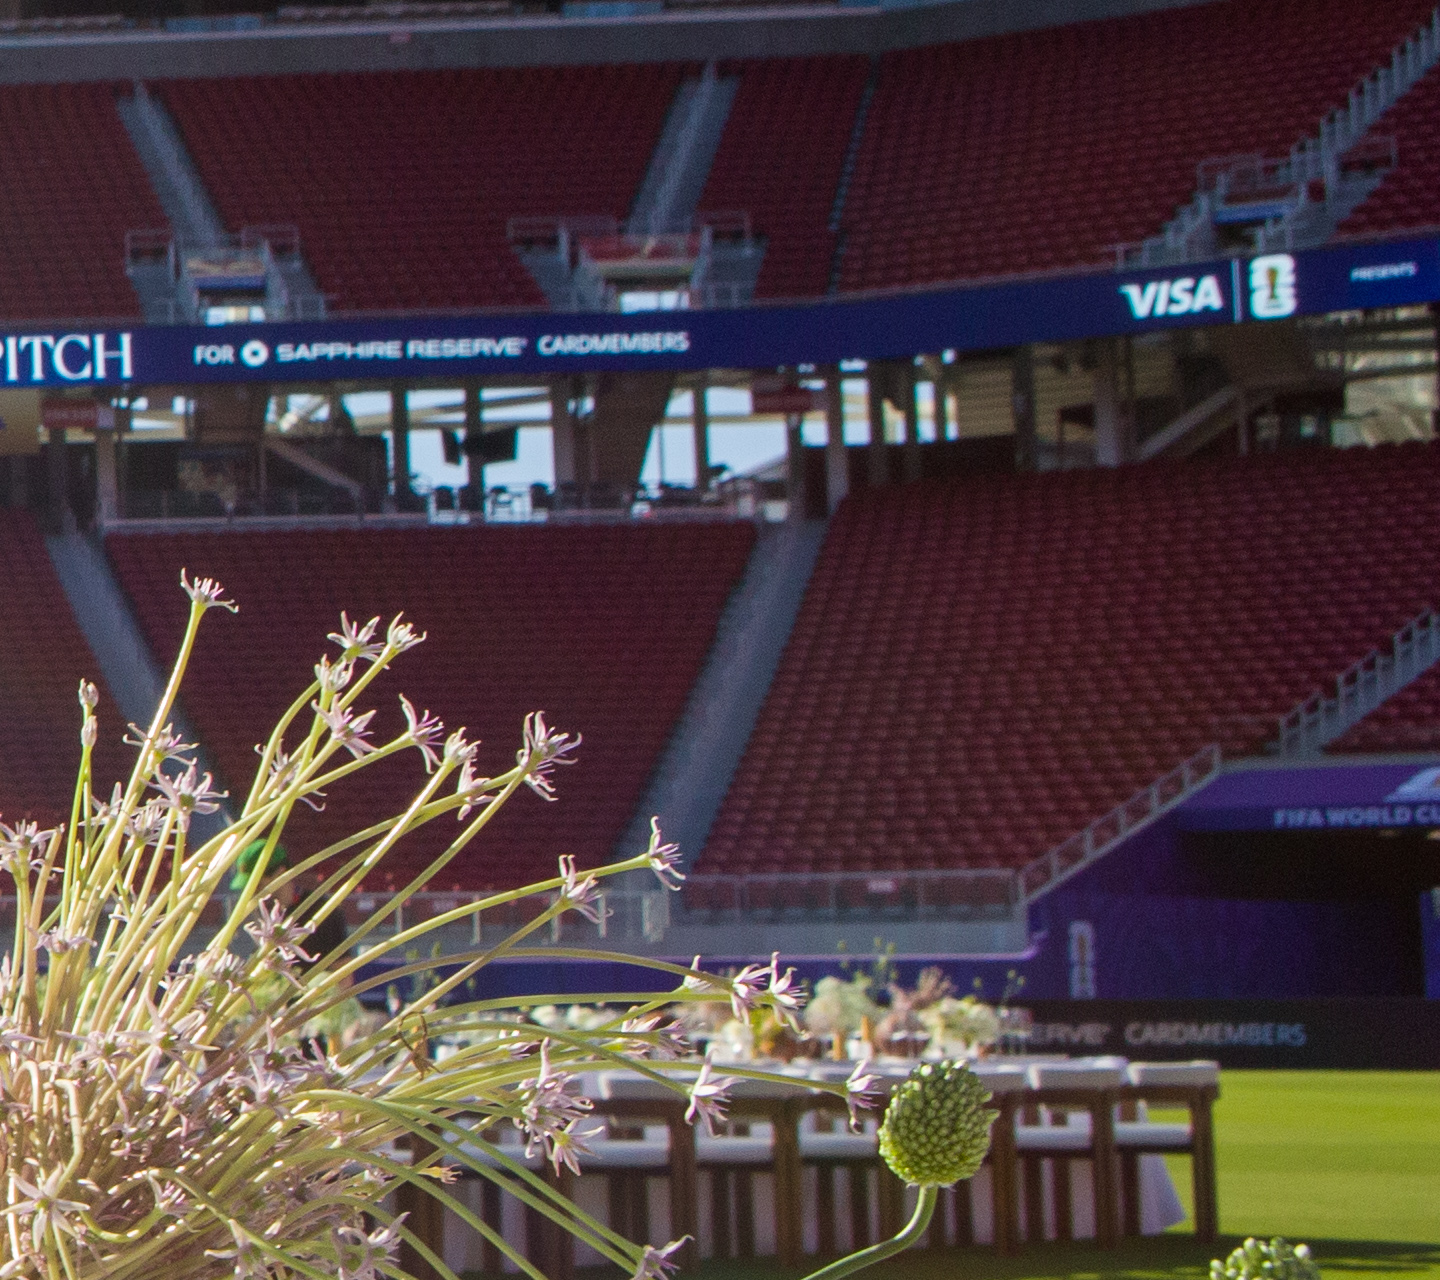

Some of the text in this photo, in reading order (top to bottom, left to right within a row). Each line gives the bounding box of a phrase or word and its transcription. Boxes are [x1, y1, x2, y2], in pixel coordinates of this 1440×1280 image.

[1117, 275, 1224, 319] VISA
[194, 345, 234, 365] FOR
[277, 341, 402, 361] SAPPHIRE
[538, 331, 690, 356] CARDMEMBERS
